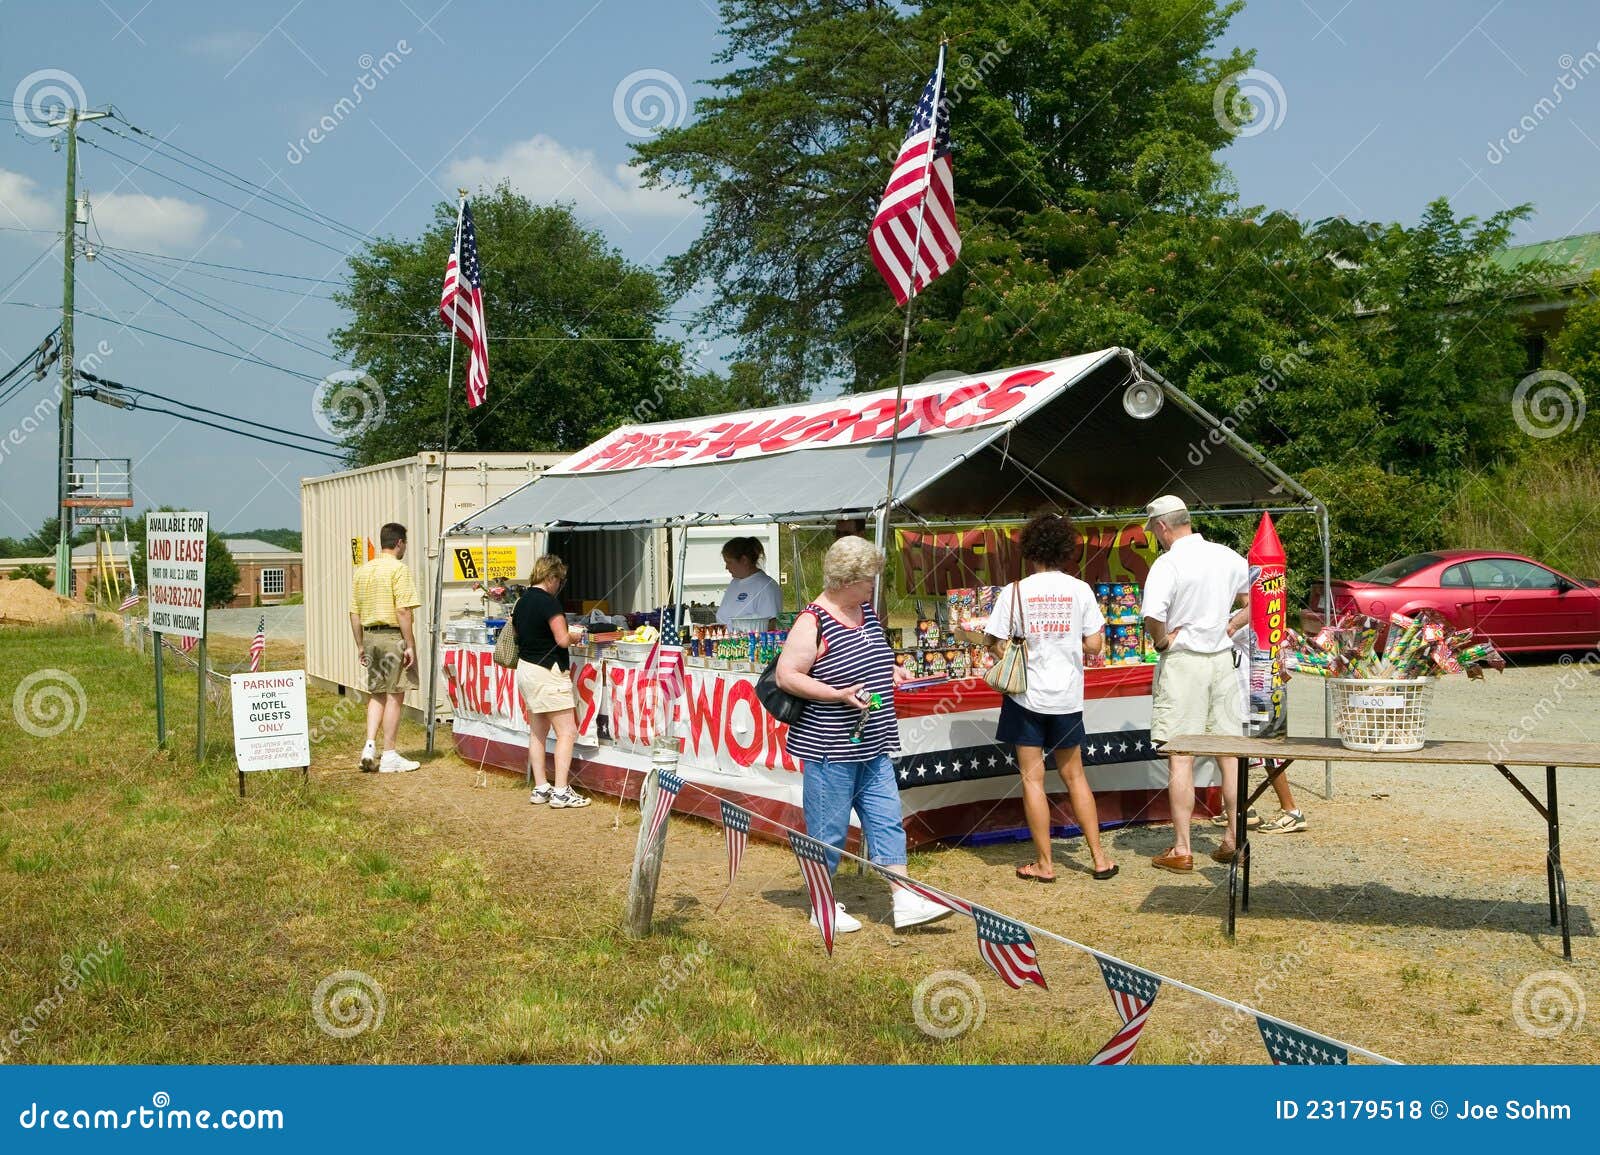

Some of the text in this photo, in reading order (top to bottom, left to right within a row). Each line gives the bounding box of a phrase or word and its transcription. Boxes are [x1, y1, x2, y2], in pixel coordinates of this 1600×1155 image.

[568, 370, 1054, 472] FIREWORKS
[149, 518, 204, 533] AVAILABLE FOR
[148, 539, 204, 562] LAND LEASE
[900, 525, 1152, 597] FIREWKS
[152, 568, 162, 578] PART
[162, 568, 168, 579] OR
[169, 569, 177, 580] ALL
[186, 569, 198, 581] ACRES
[1263, 576, 1286, 592] TNT
[149, 585, 202, 608] 1-804-282-2242
[152, 611, 200, 631] AGENTS WELCOME
[243, 678, 294, 690] PARKING
[444, 649, 598, 737] FIREWS
[252, 700, 287, 711] MOTEL
[249, 711, 291, 722] GUESTS
[258, 723, 284, 733] ONLY
